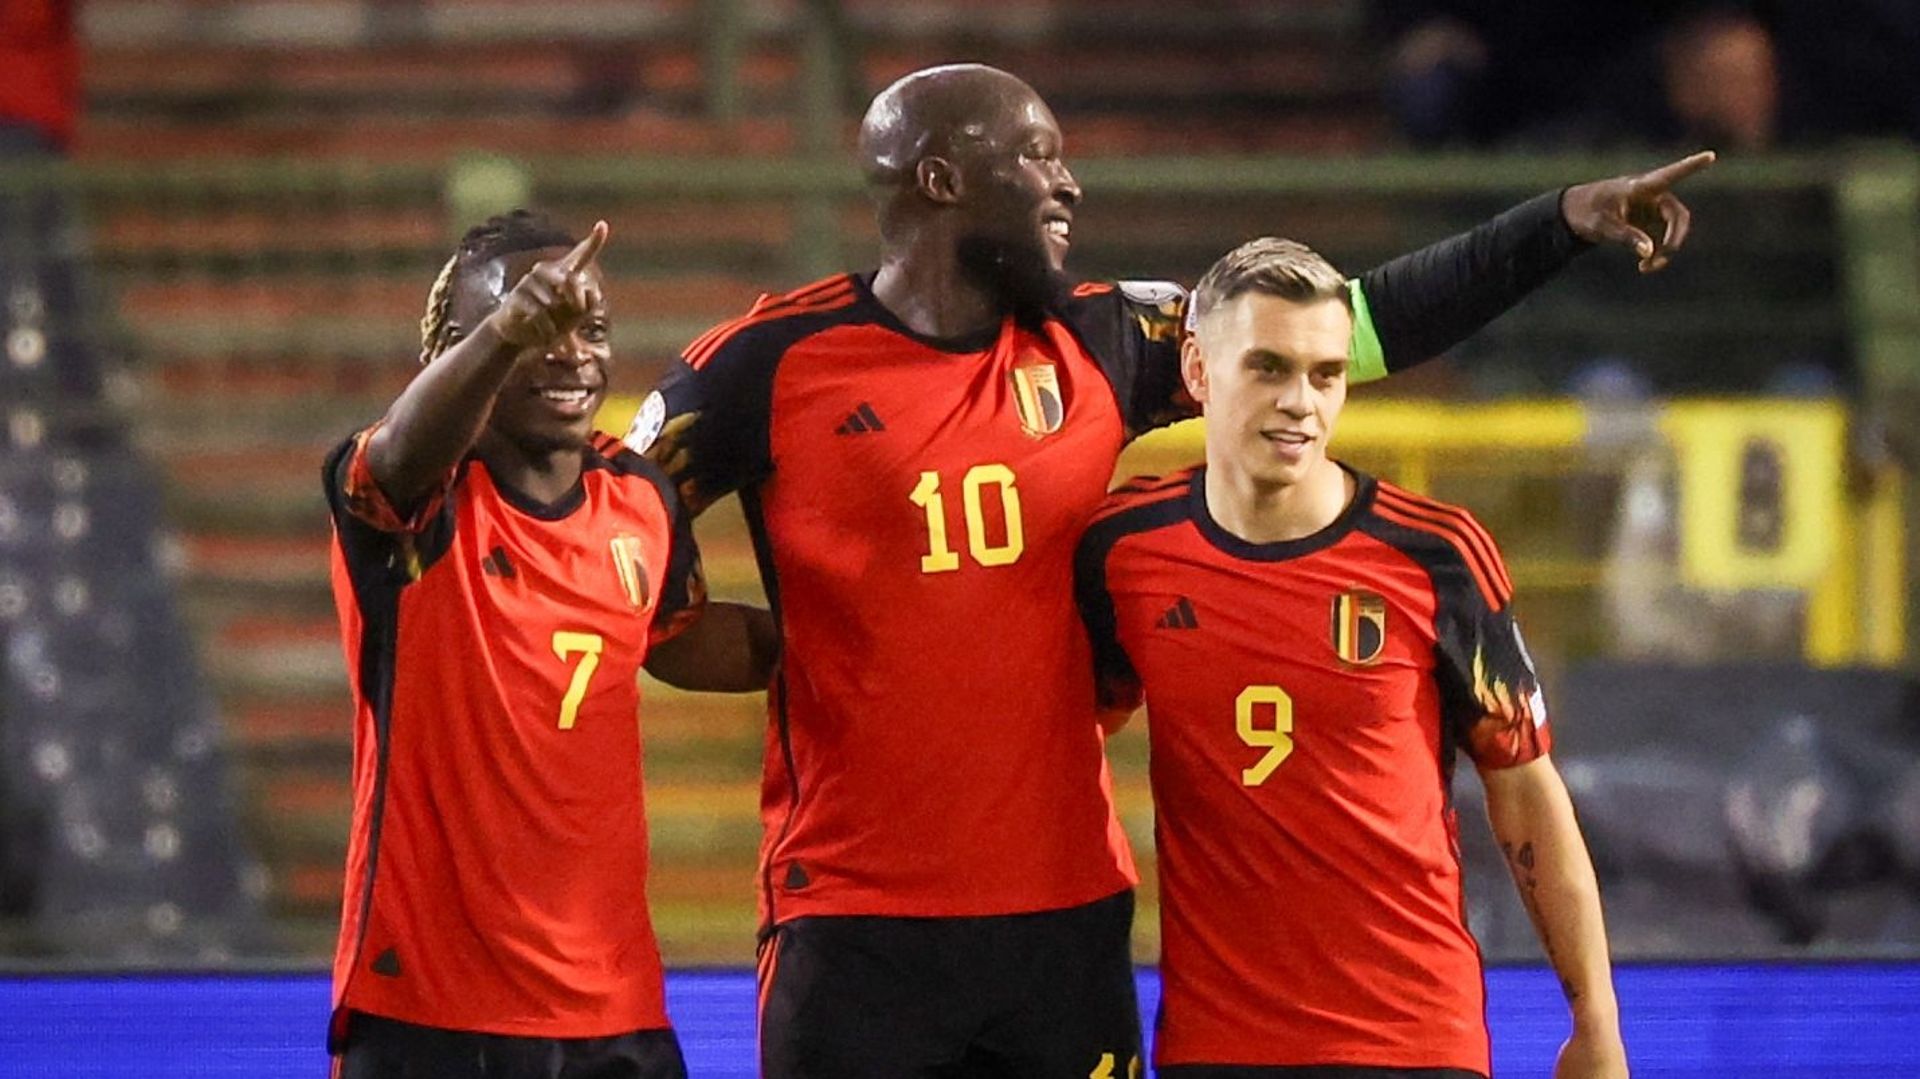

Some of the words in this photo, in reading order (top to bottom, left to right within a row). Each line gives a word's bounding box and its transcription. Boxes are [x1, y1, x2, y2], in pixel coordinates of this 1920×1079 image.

[908, 463, 1024, 573] 10
[552, 630, 603, 729] 7
[1235, 685, 1294, 787] 9
